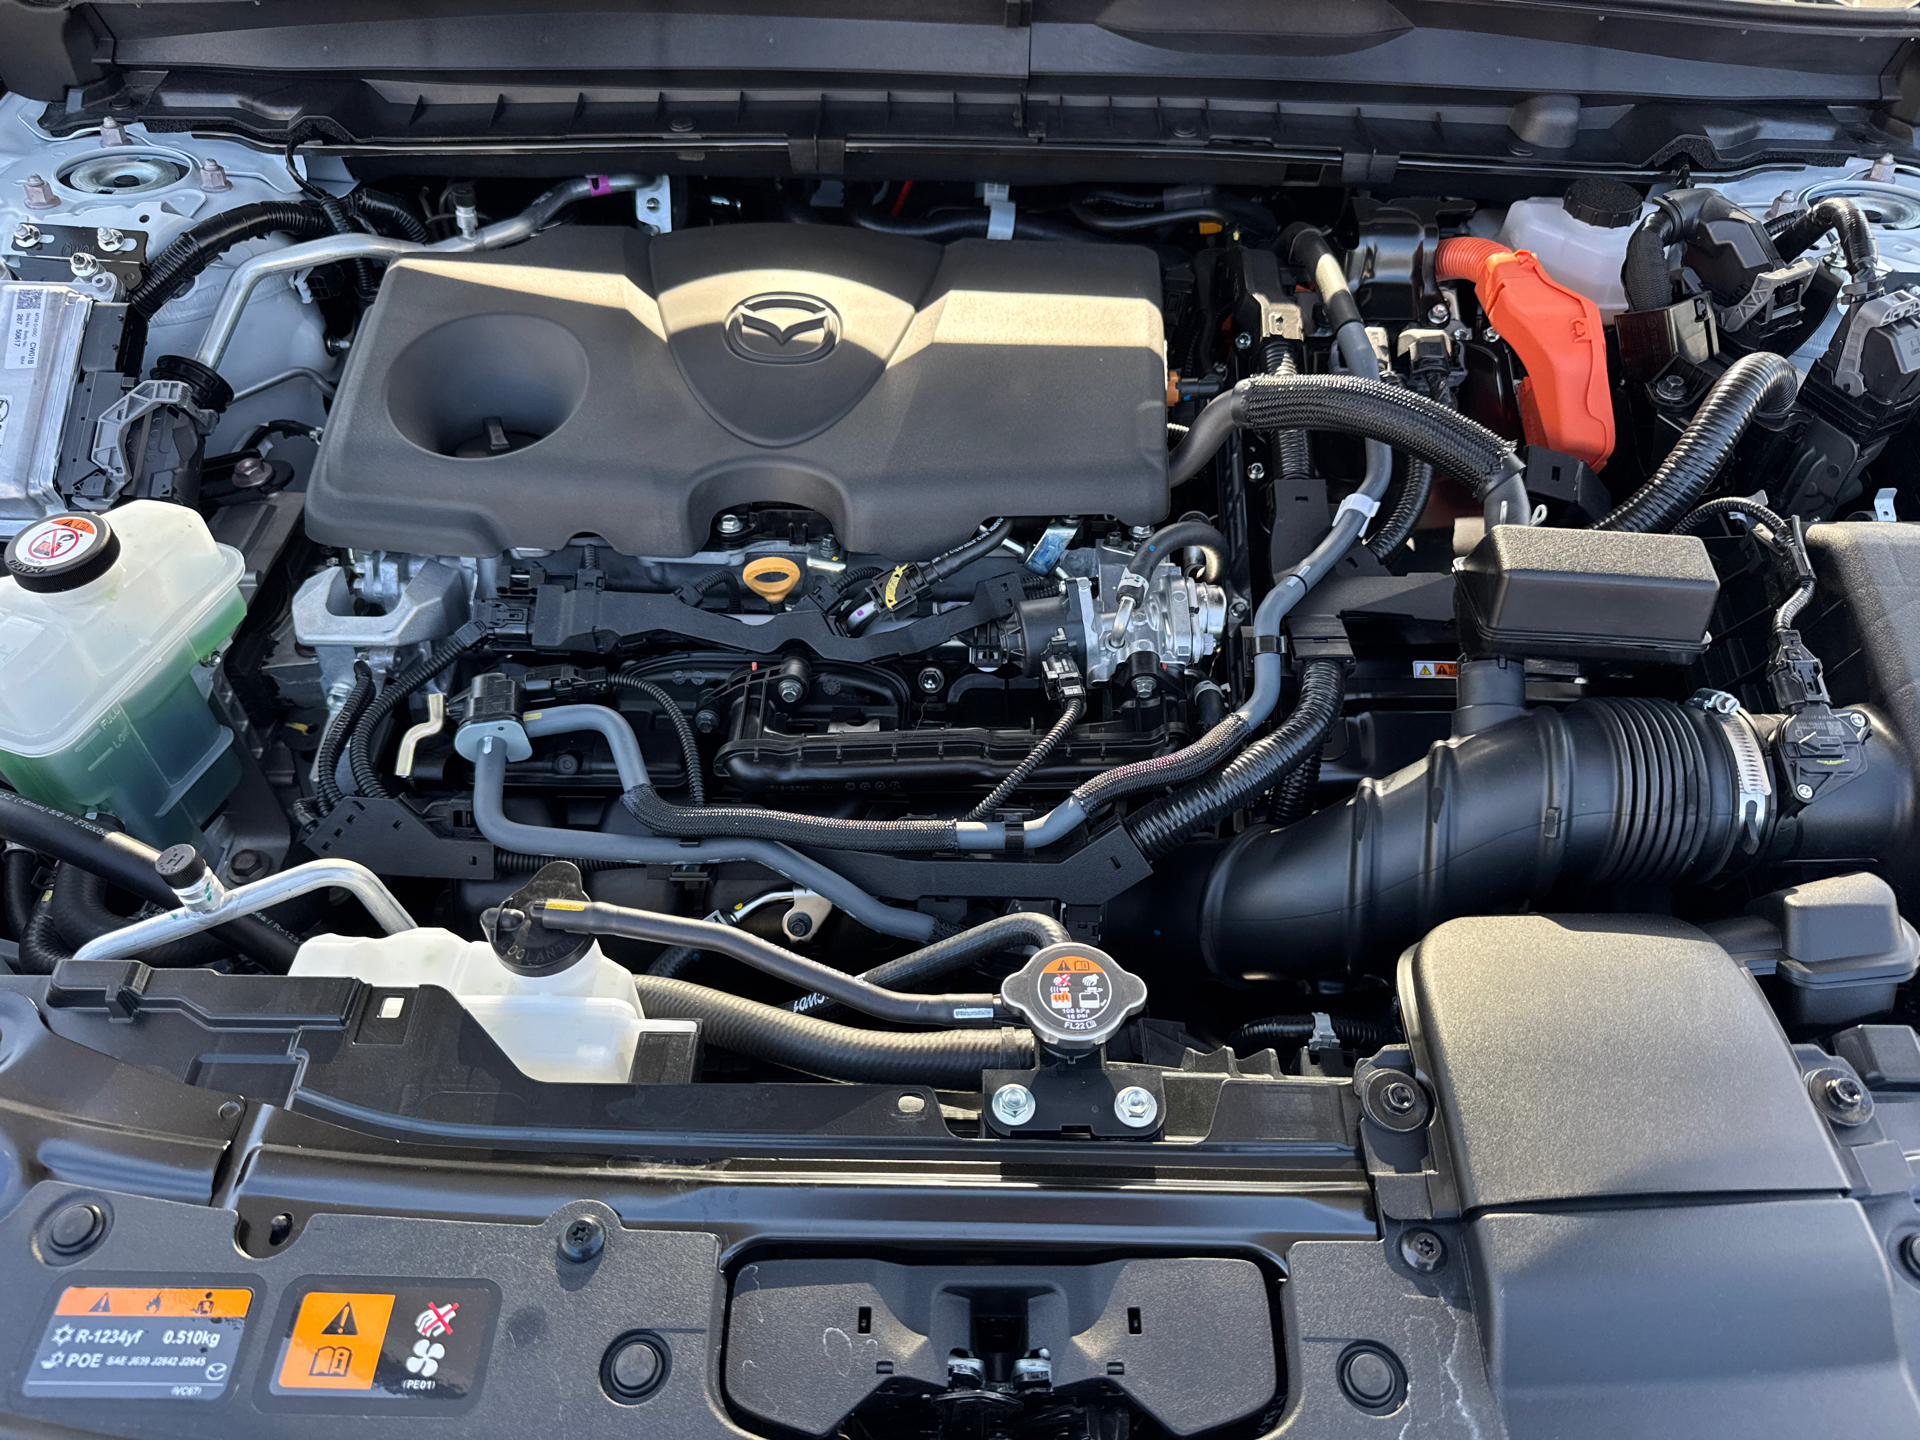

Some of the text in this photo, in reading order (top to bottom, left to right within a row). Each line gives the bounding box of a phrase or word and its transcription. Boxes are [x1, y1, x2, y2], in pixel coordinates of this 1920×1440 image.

[16, 313, 24, 325] 287
[100, 707, 121, 731] FULL
[14, 798, 48, 812] (16mm)
[47, 809, 65, 818] 5/8
[1064, 1021, 1085, 1029] FL22
[75, 1329, 221, 1348] R-1234yf 0.510kg
[65, 1352, 103, 1369] POE
[106, 1356, 128, 1366] SAE
[402, 1379, 436, 1390] (PE01)
